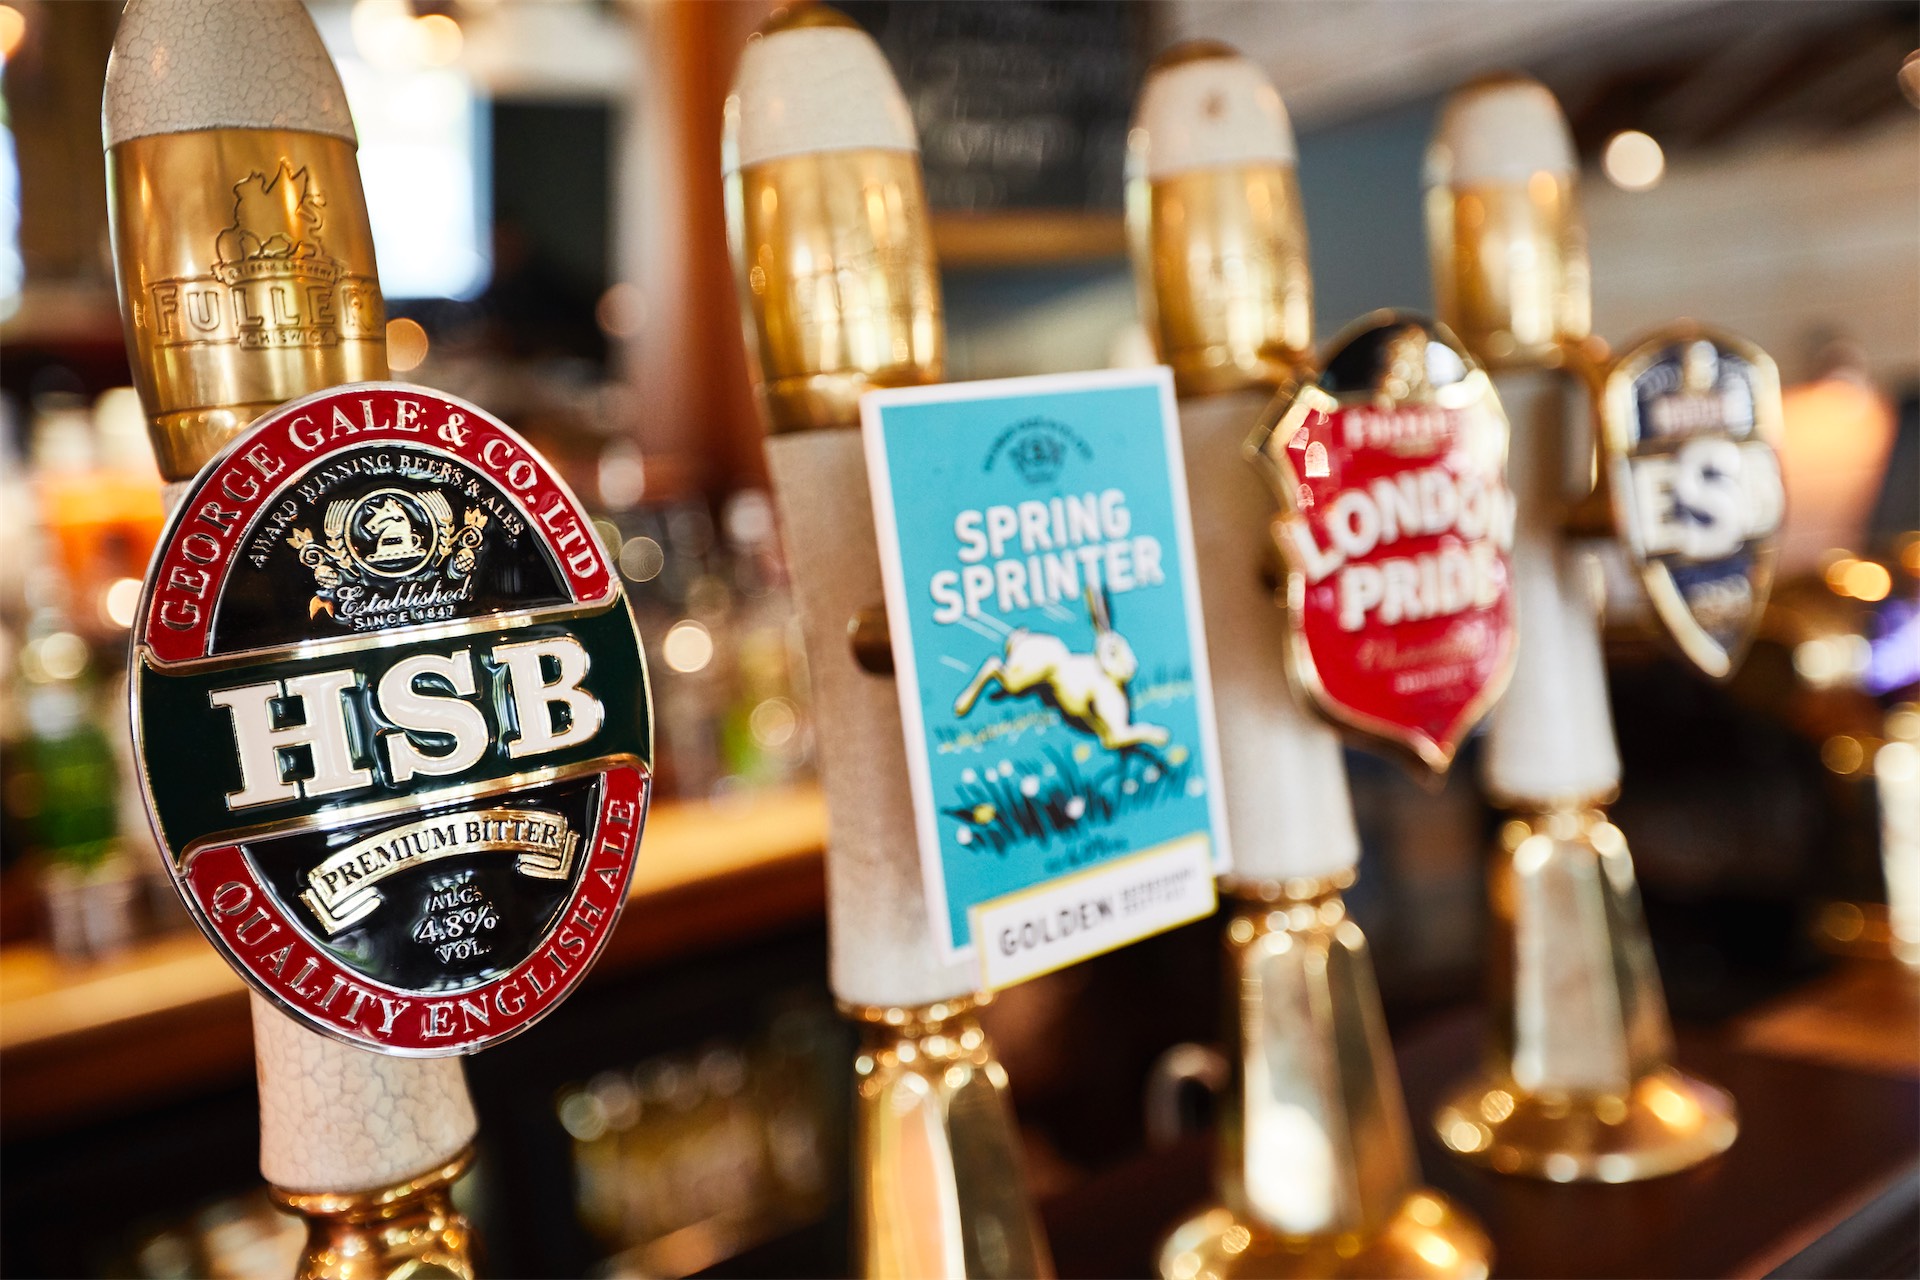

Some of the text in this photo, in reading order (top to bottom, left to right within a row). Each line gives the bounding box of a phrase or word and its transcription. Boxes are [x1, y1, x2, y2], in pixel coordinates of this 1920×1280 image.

[161, 443, 286, 631] GEORGE
[288, 399, 422, 452] GALE
[438, 411, 471, 447] &
[540, 498, 599, 580] LTD
[249, 500, 298, 568] AWARD
[296, 453, 391, 505] WINNING
[464, 478, 481, 499] &
[482, 496, 525, 536] ALES
[954, 488, 1131, 563] SPRING
[1290, 468, 1516, 584] LONDON
[336, 574, 471, 616] Established
[354, 604, 454, 629] SINCE 1847
[930, 535, 1165, 624] SPRINTER
[210, 636, 603, 811] HSB
[321, 817, 561, 896] PREMIUM BITTER
[210, 799, 636, 1038] QUALITY ENGLISH ALE
[418, 906, 497, 942] 4.8%
[998, 896, 1115, 956] GOLDEN
